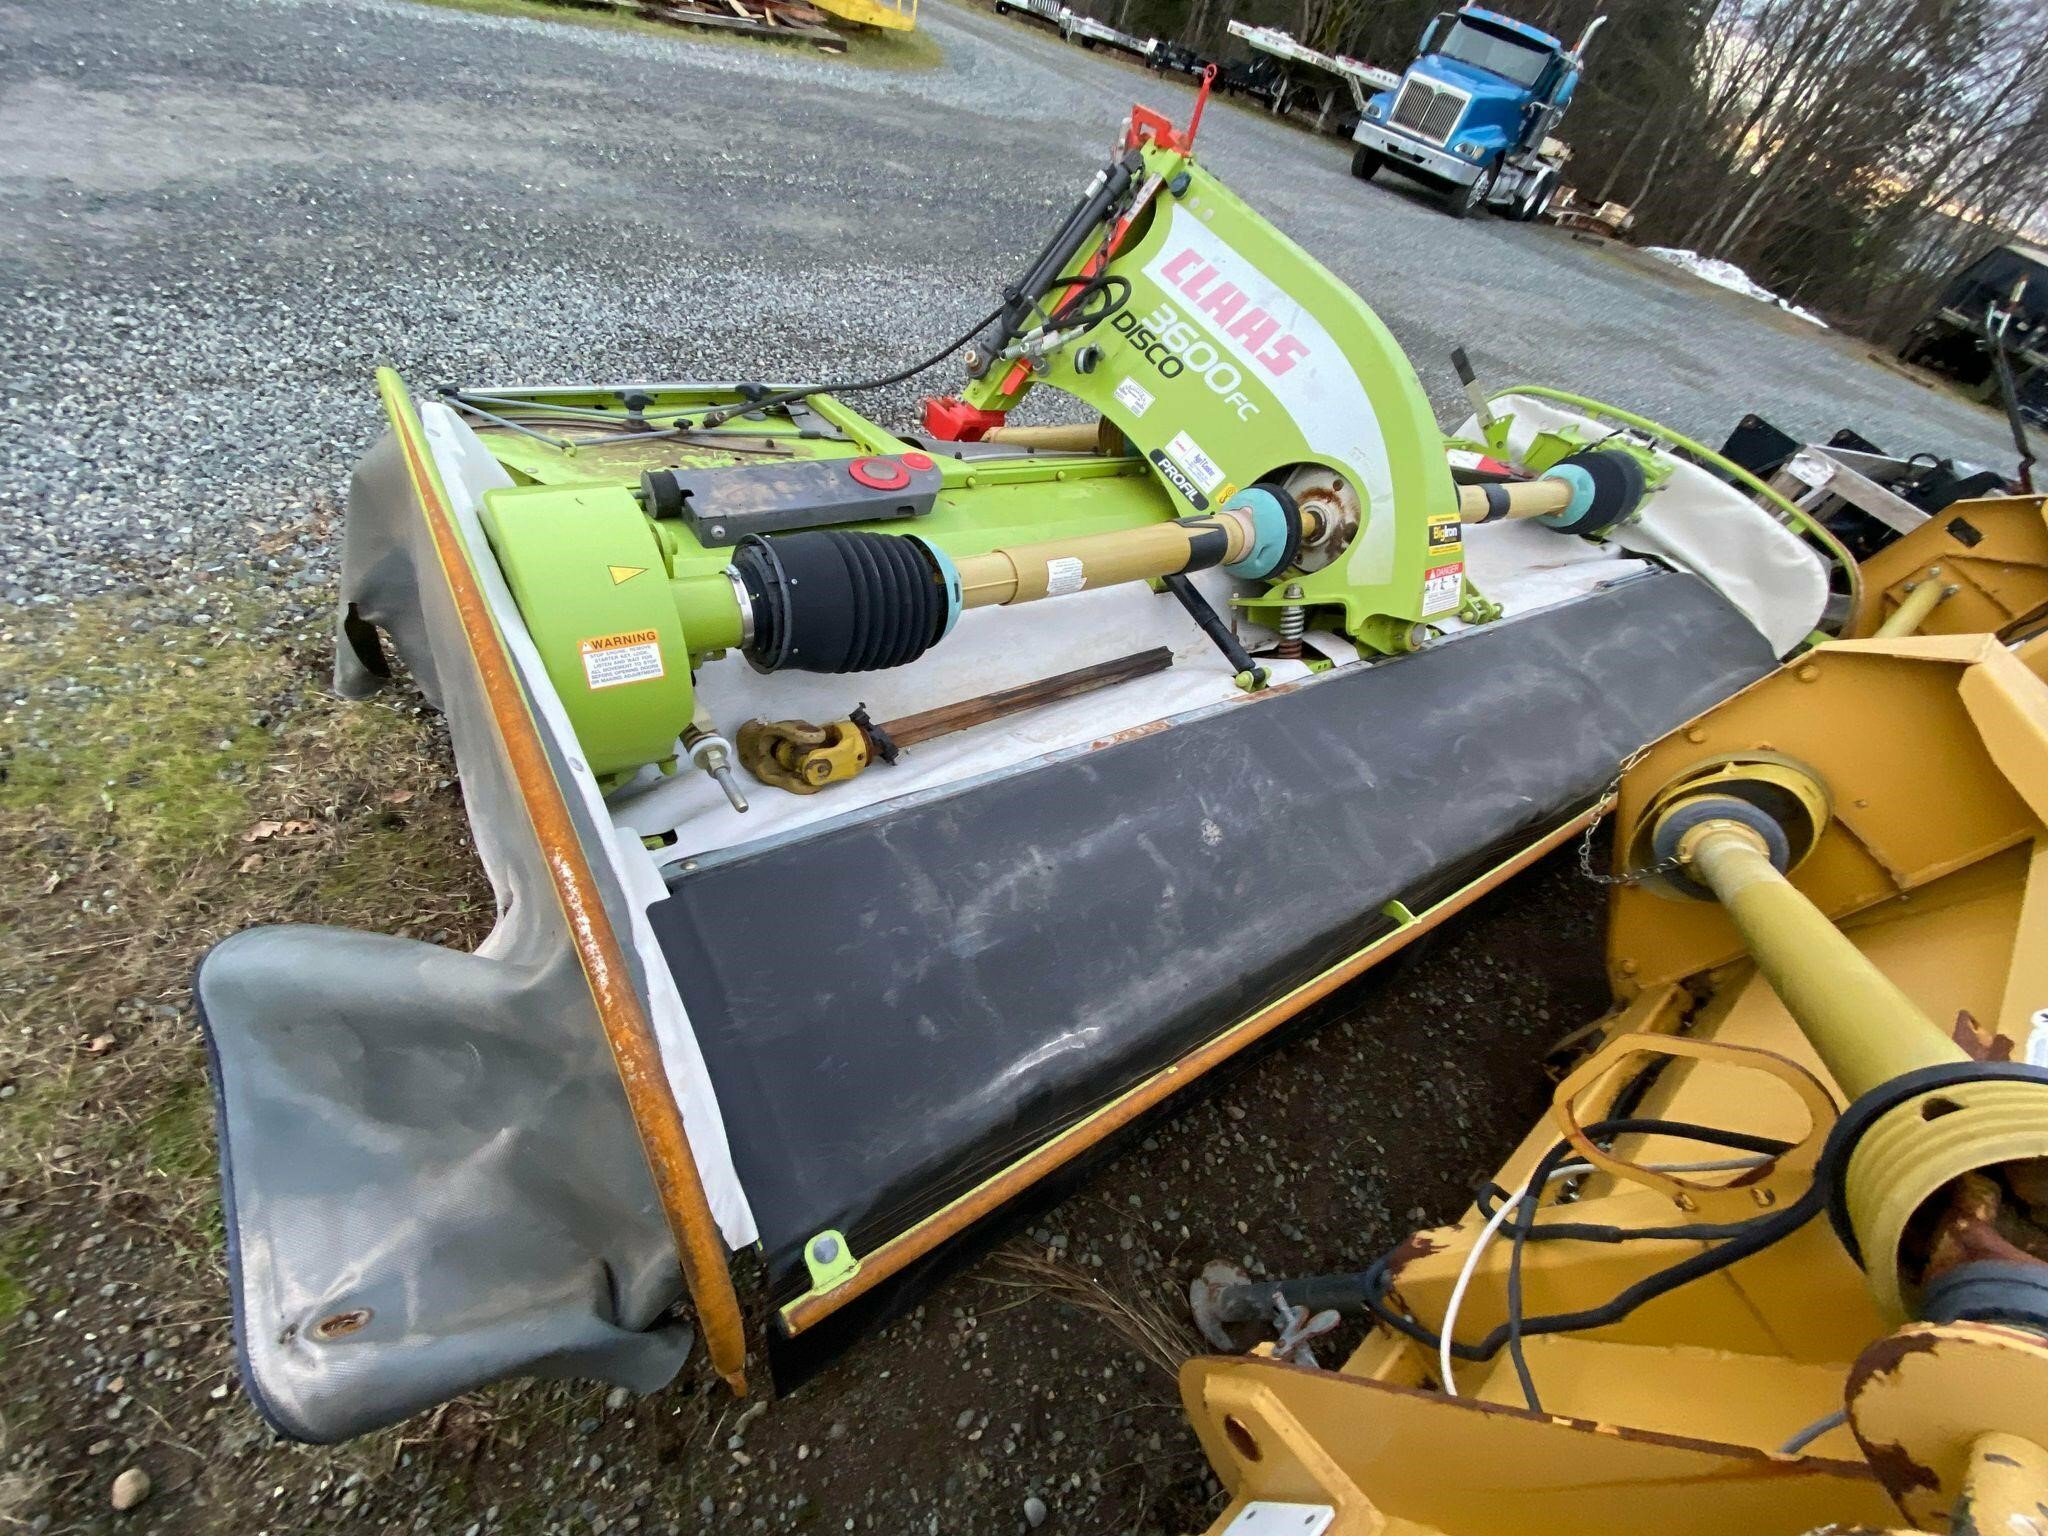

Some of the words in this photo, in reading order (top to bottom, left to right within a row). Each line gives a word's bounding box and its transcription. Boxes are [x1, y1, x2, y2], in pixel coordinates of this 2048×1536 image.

[1160, 248, 1311, 377] CLAAS
[1110, 310, 1184, 379] DISCO
[1158, 458, 1198, 502] PROFIL
[1436, 565, 1459, 577] DANGER
[592, 632, 656, 650] WARNING
